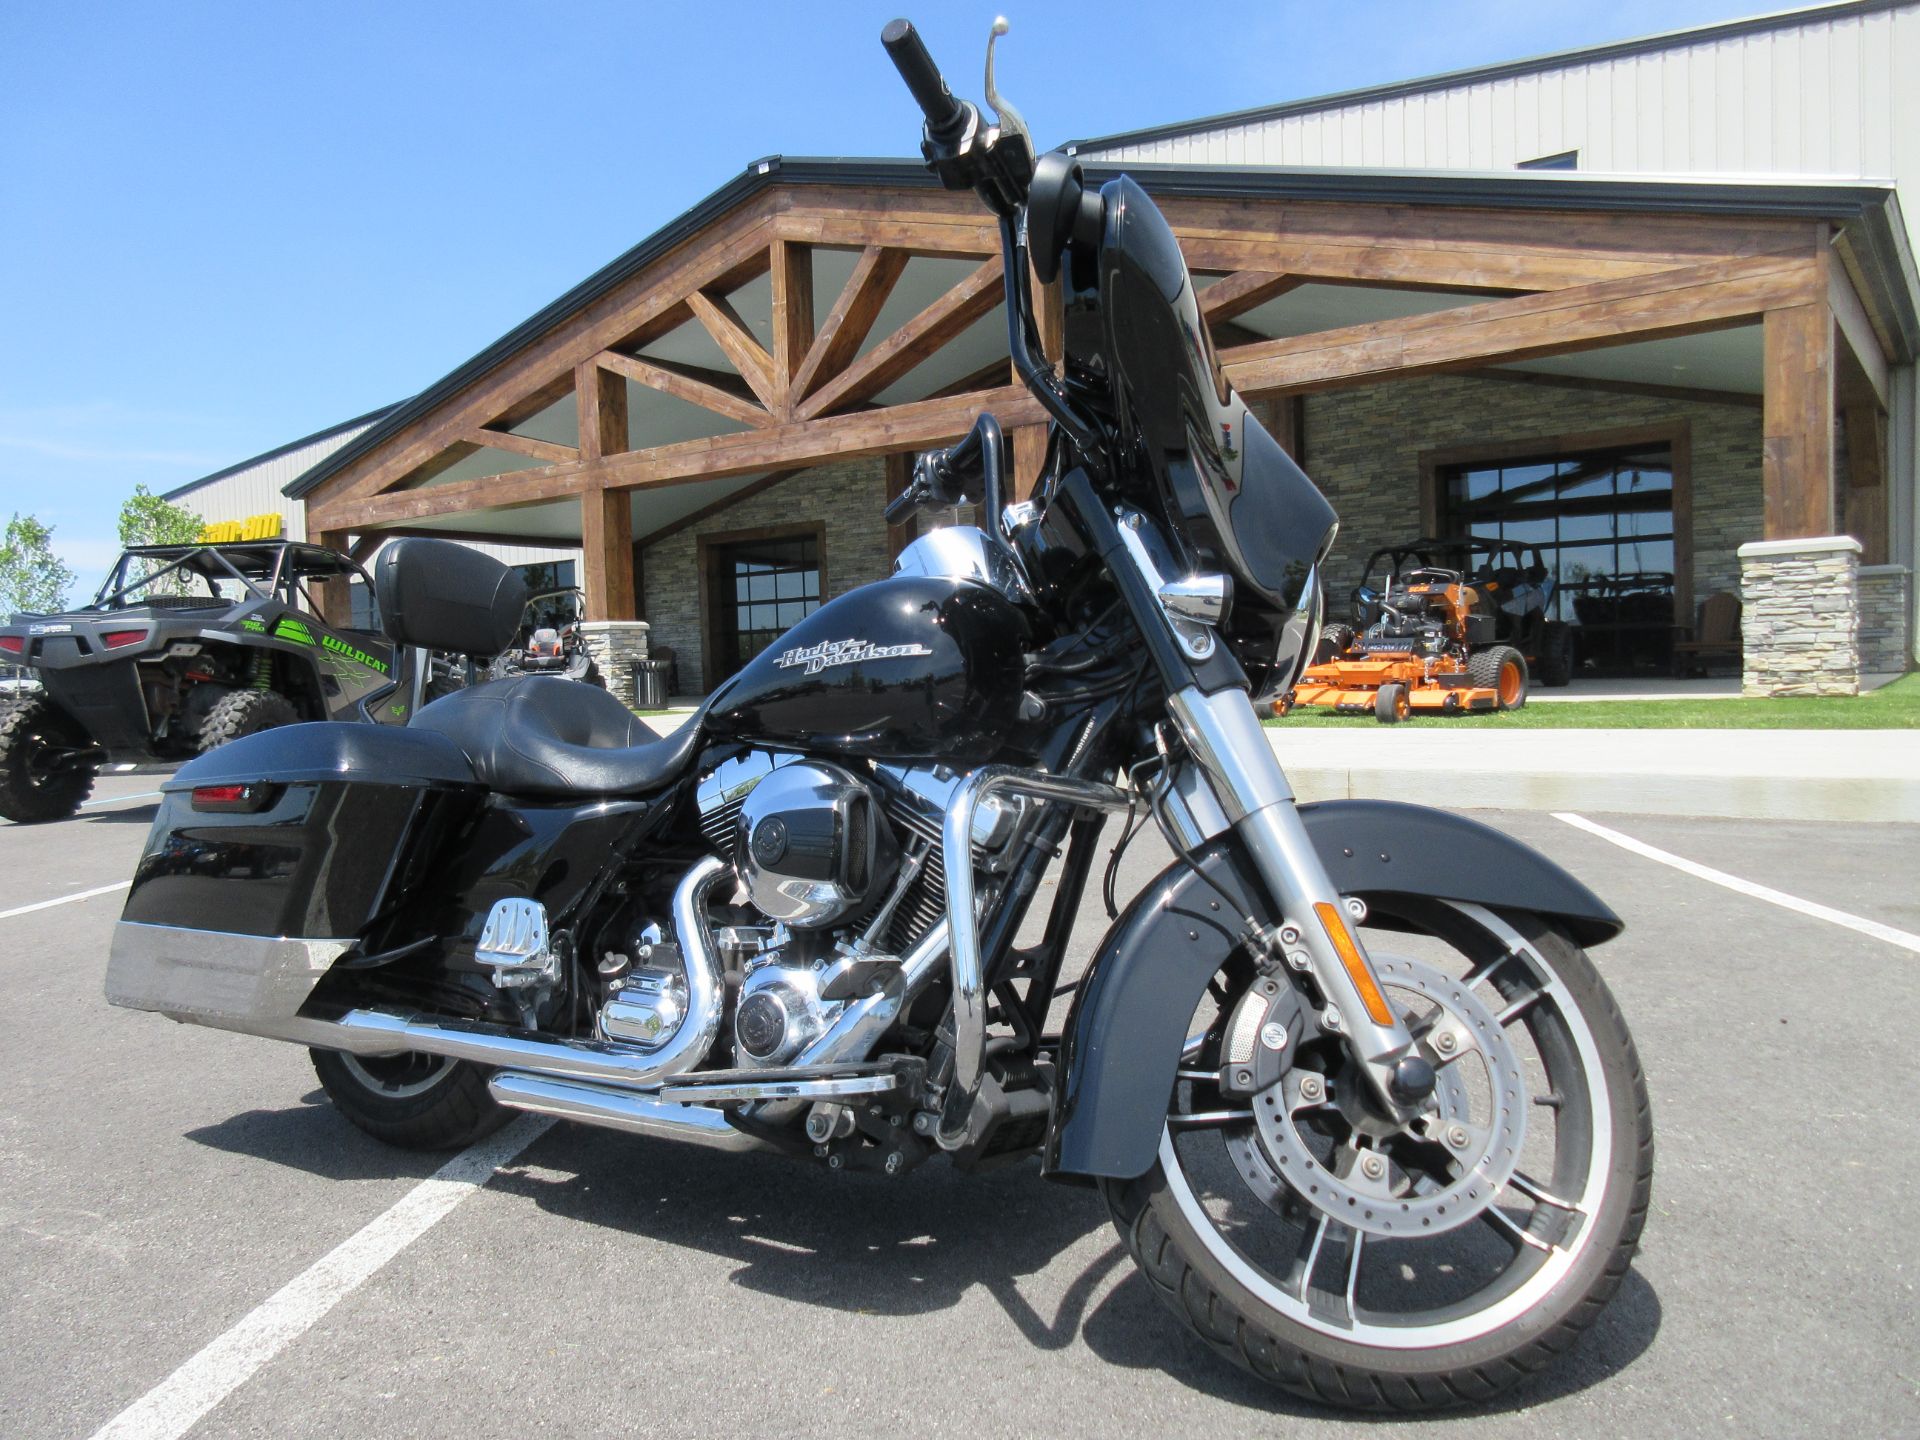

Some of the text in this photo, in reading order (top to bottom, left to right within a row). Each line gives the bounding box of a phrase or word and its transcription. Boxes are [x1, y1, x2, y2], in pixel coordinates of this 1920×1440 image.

[322, 634, 389, 674] WILDCAT
[773, 638, 868, 668] Harley
[804, 643, 933, 675] Davidson
